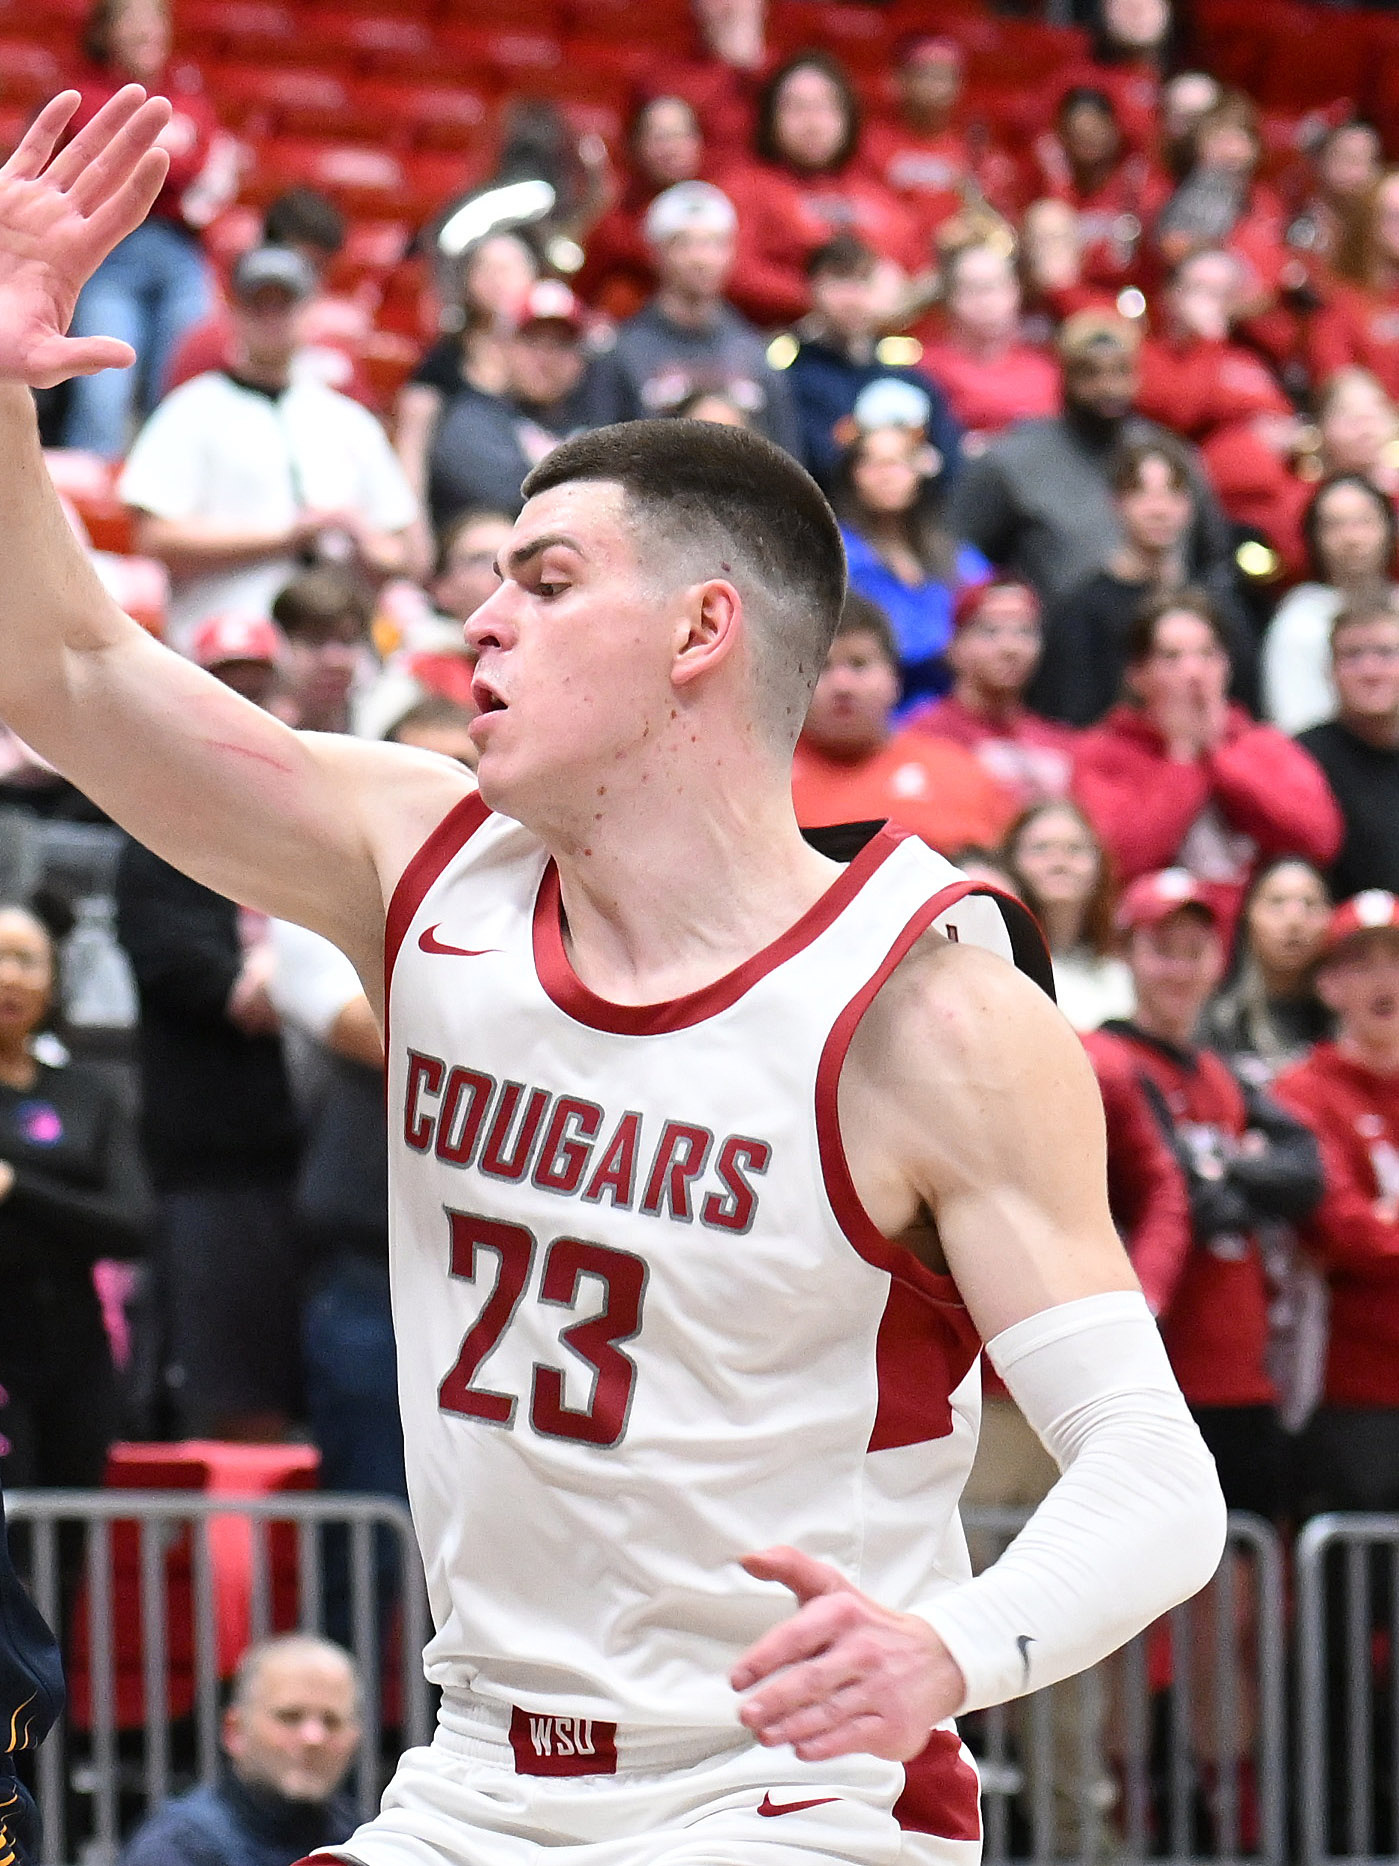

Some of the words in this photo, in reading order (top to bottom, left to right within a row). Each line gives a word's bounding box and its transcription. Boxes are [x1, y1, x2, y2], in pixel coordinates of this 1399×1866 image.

[403, 1047, 773, 1236] COUGARS
[437, 1202, 650, 1450] 23
[528, 1717, 596, 1757] WSU
